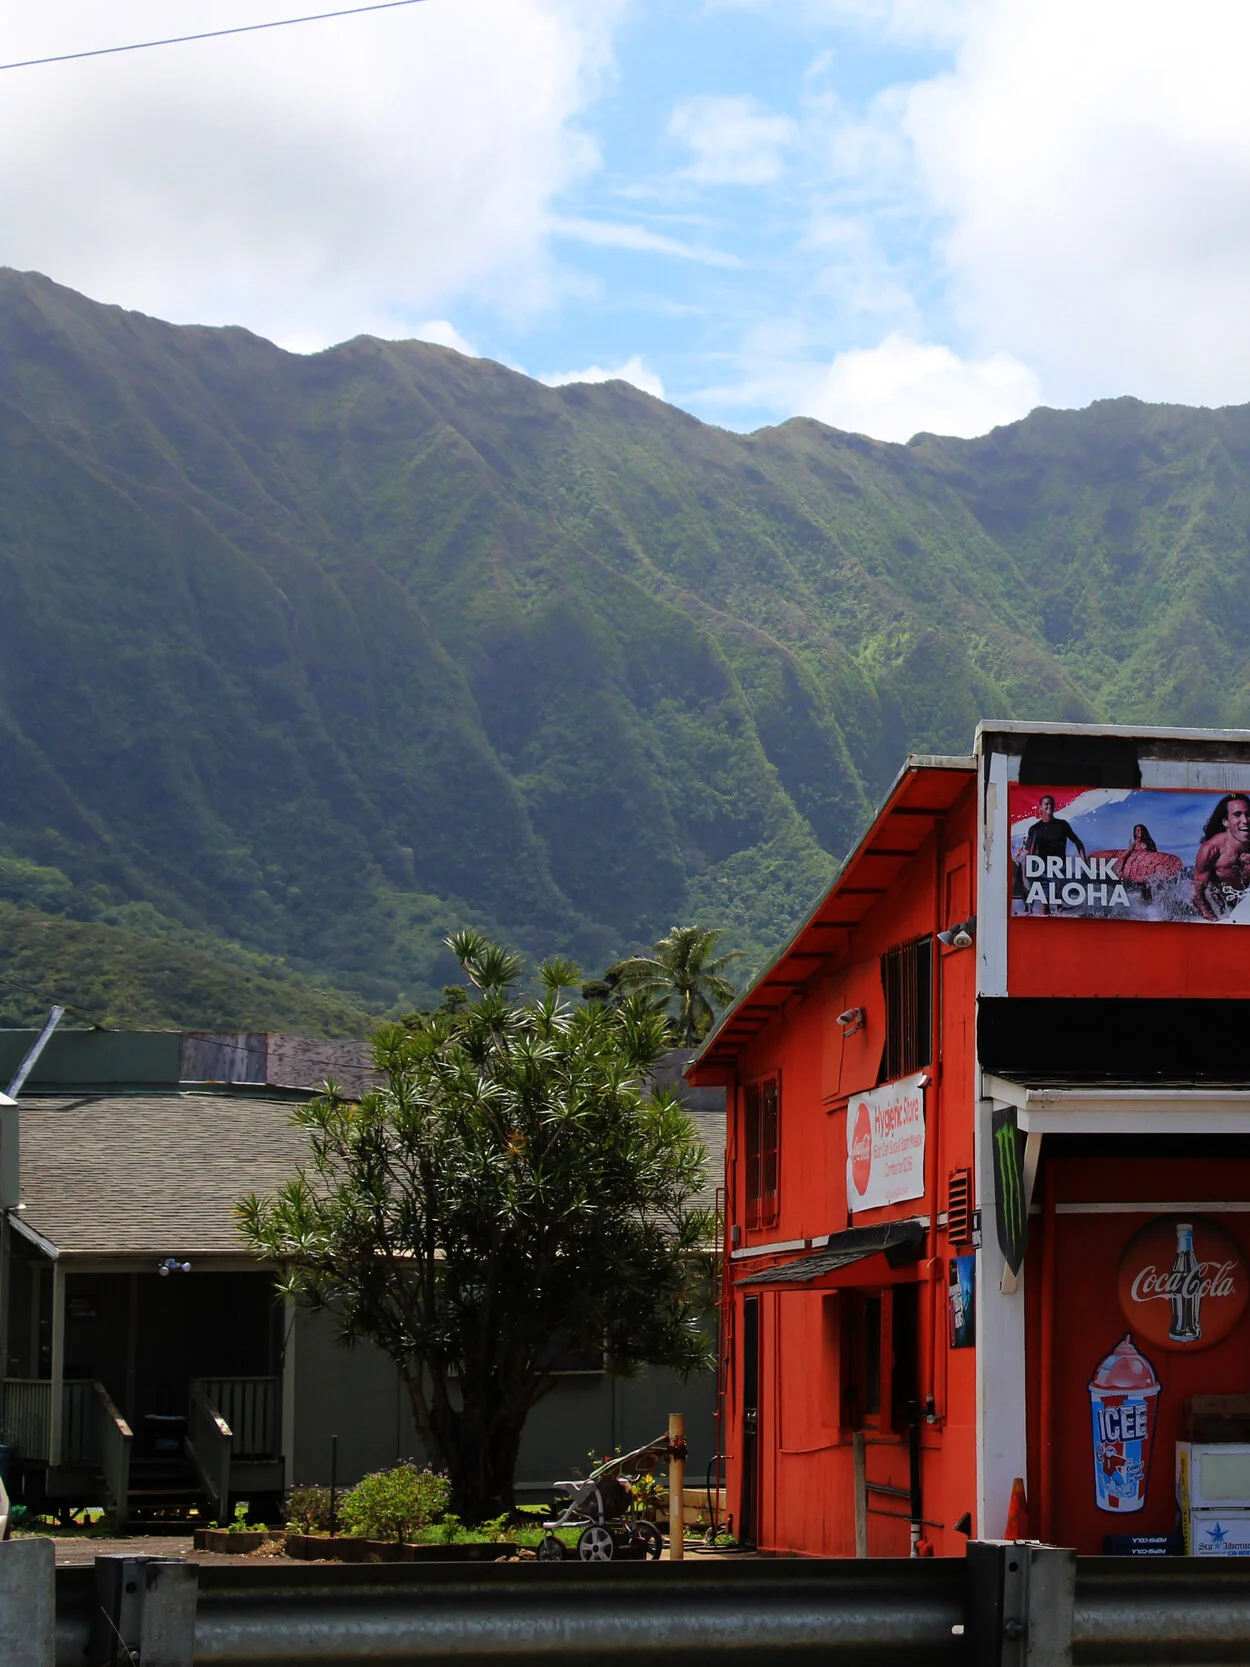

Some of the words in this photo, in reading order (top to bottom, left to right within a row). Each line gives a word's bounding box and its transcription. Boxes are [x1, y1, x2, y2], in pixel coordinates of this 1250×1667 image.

[1025, 855, 1120, 880] DRINK
[1025, 881, 1131, 907] ALOHA
[874, 1097, 902, 1138] Hygienic
[903, 1095, 919, 1126] Store
[1131, 1260, 1238, 1302] Coca-Cola
[1098, 1404, 1148, 1443] ICEE
[1199, 1542, 1214, 1550] Star
